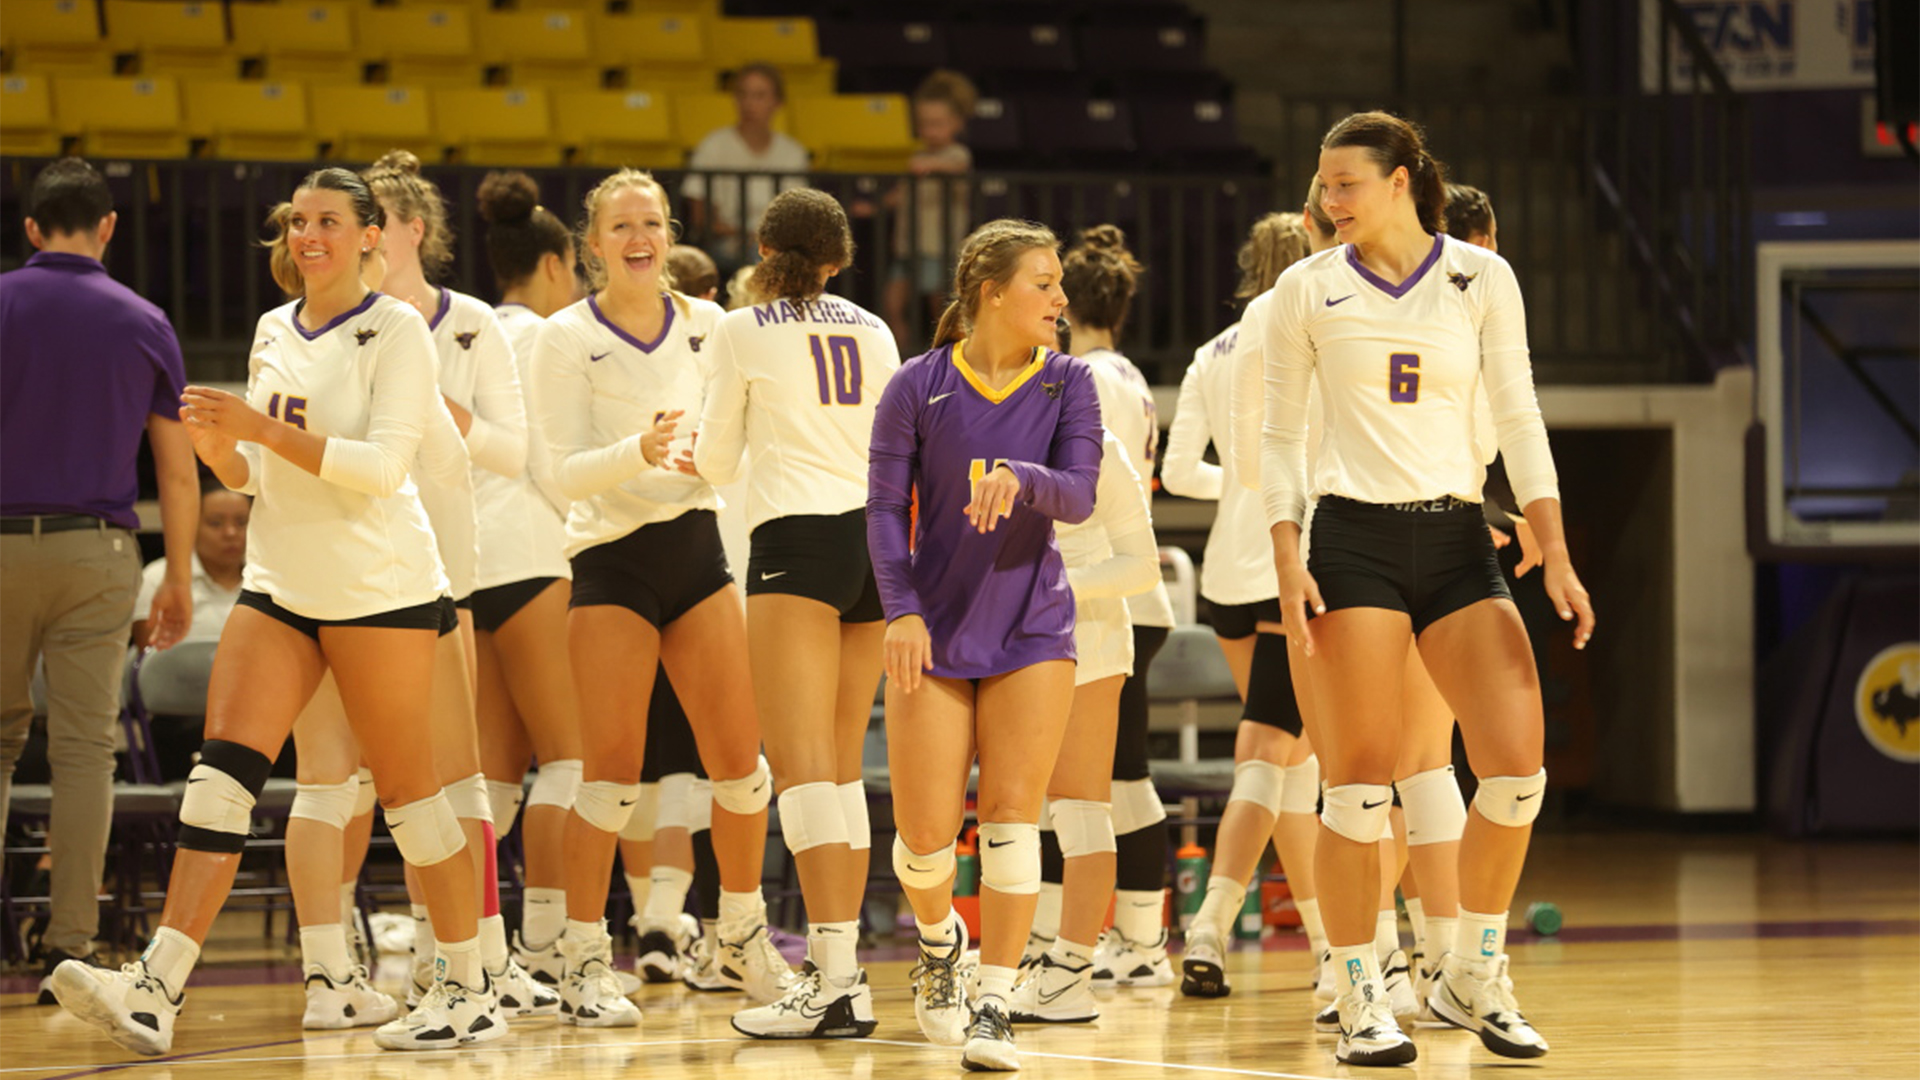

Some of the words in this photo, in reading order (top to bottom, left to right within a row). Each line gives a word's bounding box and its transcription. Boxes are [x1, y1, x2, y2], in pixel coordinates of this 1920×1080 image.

[807, 333, 864, 406] 10
[1389, 352, 1420, 404] 6
[267, 391, 308, 431] 15
[968, 458, 1010, 516] 1
